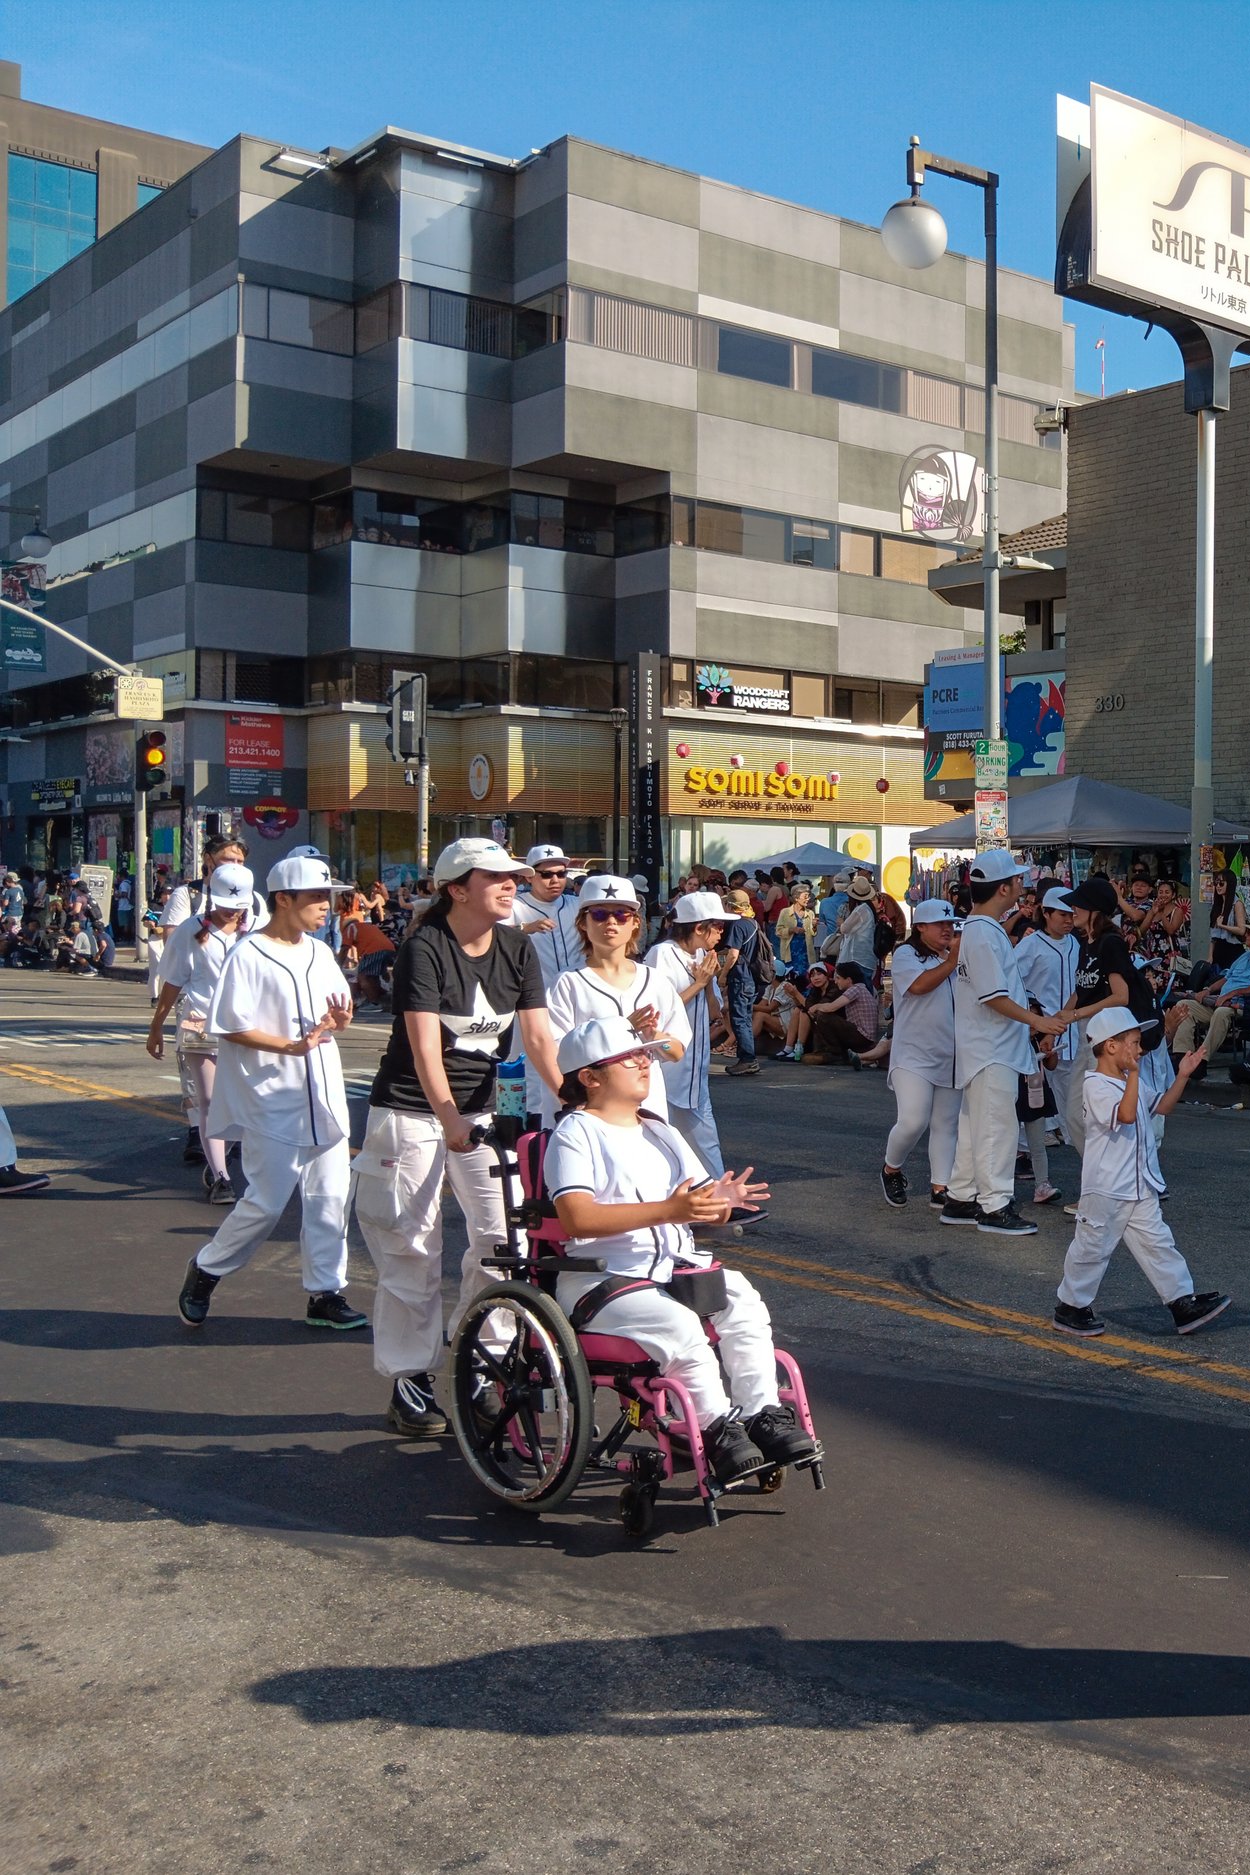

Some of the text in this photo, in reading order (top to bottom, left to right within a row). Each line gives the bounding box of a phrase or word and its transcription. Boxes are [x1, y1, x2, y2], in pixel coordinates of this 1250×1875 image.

[1152, 218, 1206, 270] SHOE
[1201, 284, 1247, 315] リトル東京
[733, 686, 790, 699] WOODCRAFT
[932, 687, 959, 703] PCRE
[733, 695, 790, 711] RANGERS
[1095, 694, 1125, 713] 330
[240, 720, 271, 728] Mathews
[647, 727, 653, 735] K
[229, 747, 281, 757] 213.421.1400
[246, 740, 271, 748] LEASE
[979, 742, 1006, 753] 2 HOUR
[646, 742, 654, 807] HASHIMOTO
[462, 1015, 502, 1035] SUPA
